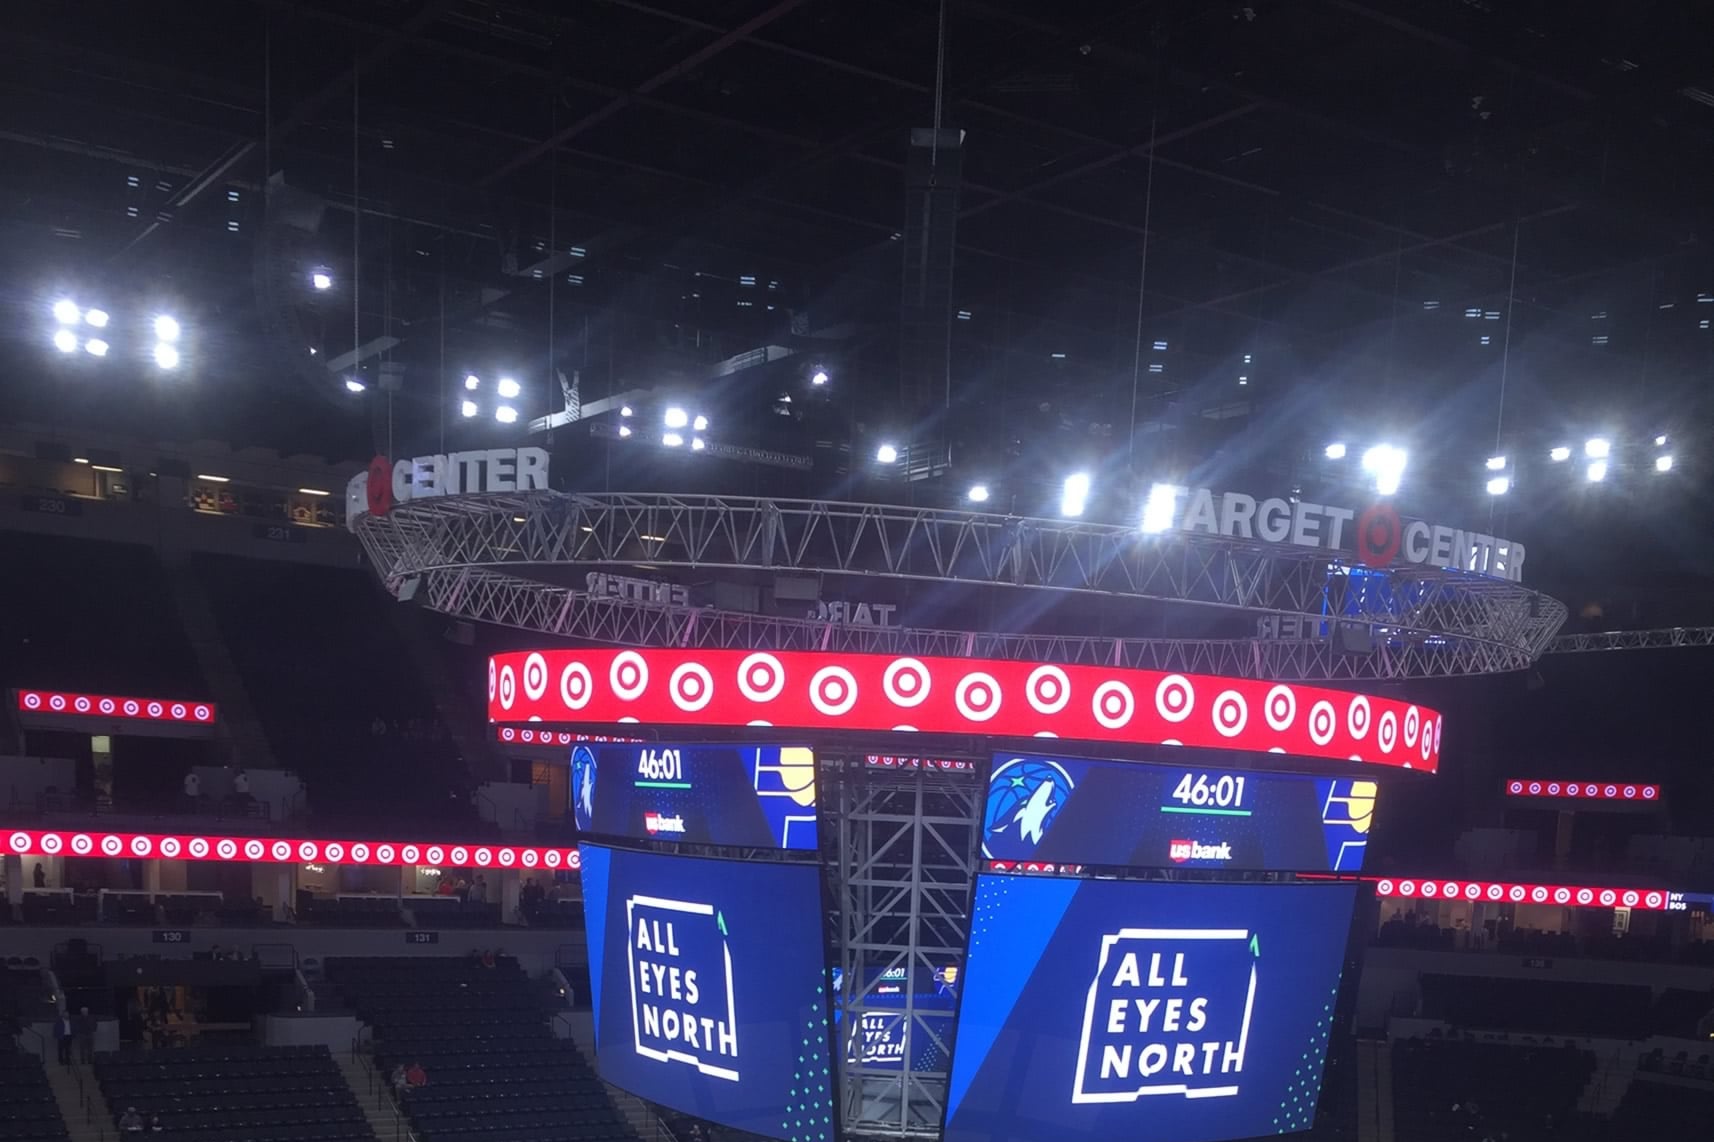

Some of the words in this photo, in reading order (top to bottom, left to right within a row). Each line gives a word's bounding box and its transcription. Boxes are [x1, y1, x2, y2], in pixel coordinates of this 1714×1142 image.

[392, 447, 550, 503] CENTER
[1405, 521, 1526, 582] CENTER
[638, 749, 682, 779] 46:01
[1172, 773, 1245, 807] 46:01
[1669, 902, 1687, 910] BOS
[163, 932, 182, 942] 130
[637, 918, 679, 956] ALL
[639, 961, 699, 1004] EYES
[1112, 952, 1188, 987] ALL
[643, 1003, 737, 1057] NORTH
[1107, 997, 1208, 1033] EYES
[1100, 1042, 1243, 1079] NORTH
